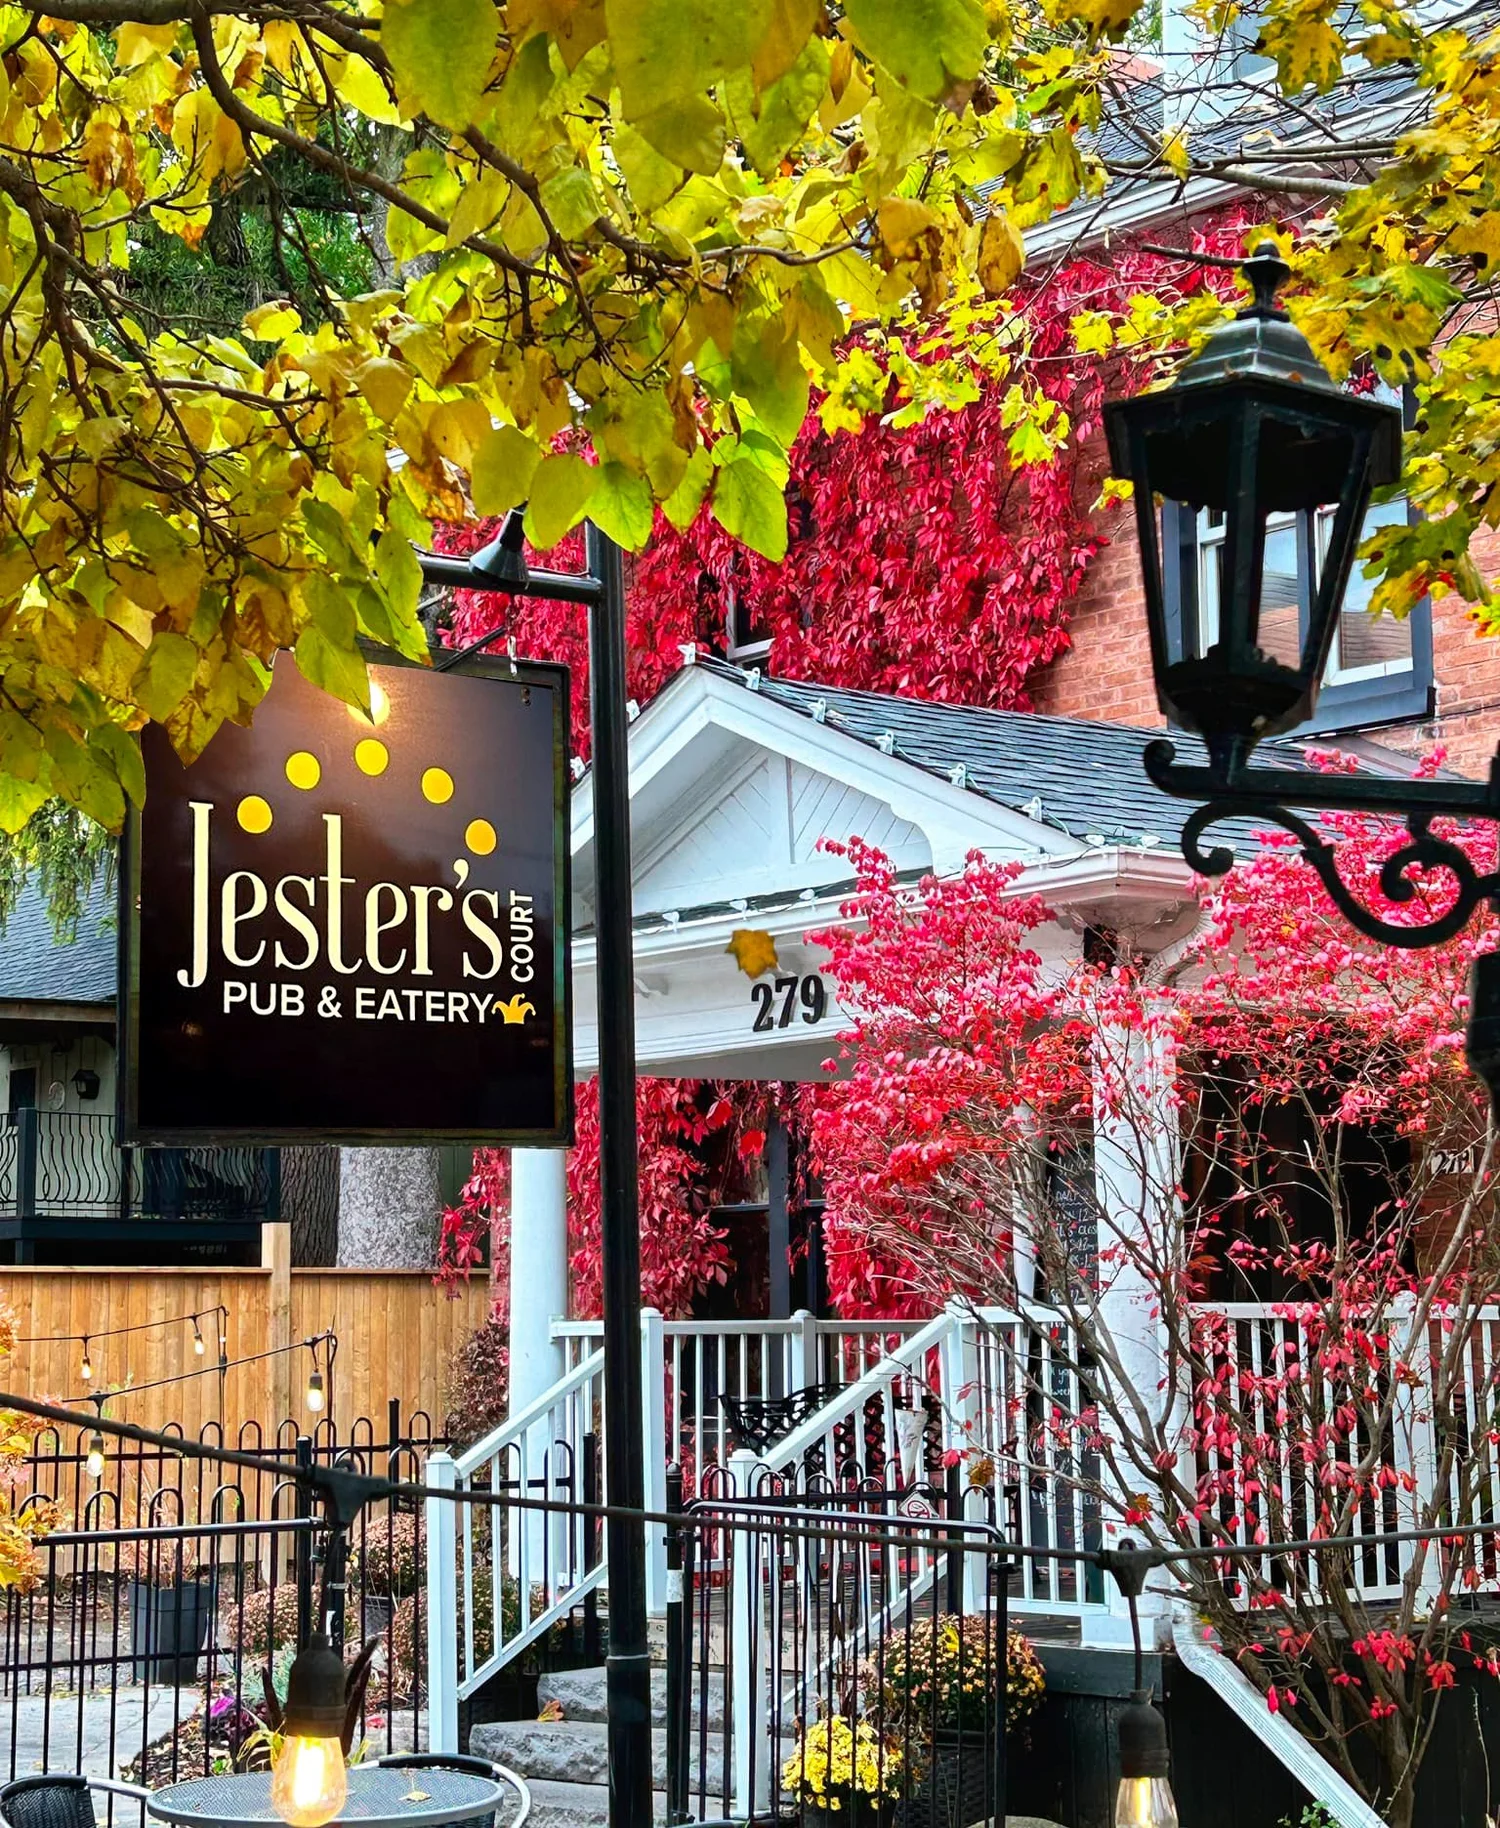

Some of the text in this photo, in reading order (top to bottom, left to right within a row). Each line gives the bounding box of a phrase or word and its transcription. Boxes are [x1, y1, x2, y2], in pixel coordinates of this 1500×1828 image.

[177, 801, 503, 988] Jester's
[509, 889, 535, 983] COURT
[223, 981, 494, 1024] PUB & EATERY
[751, 974, 825, 1032] 279
